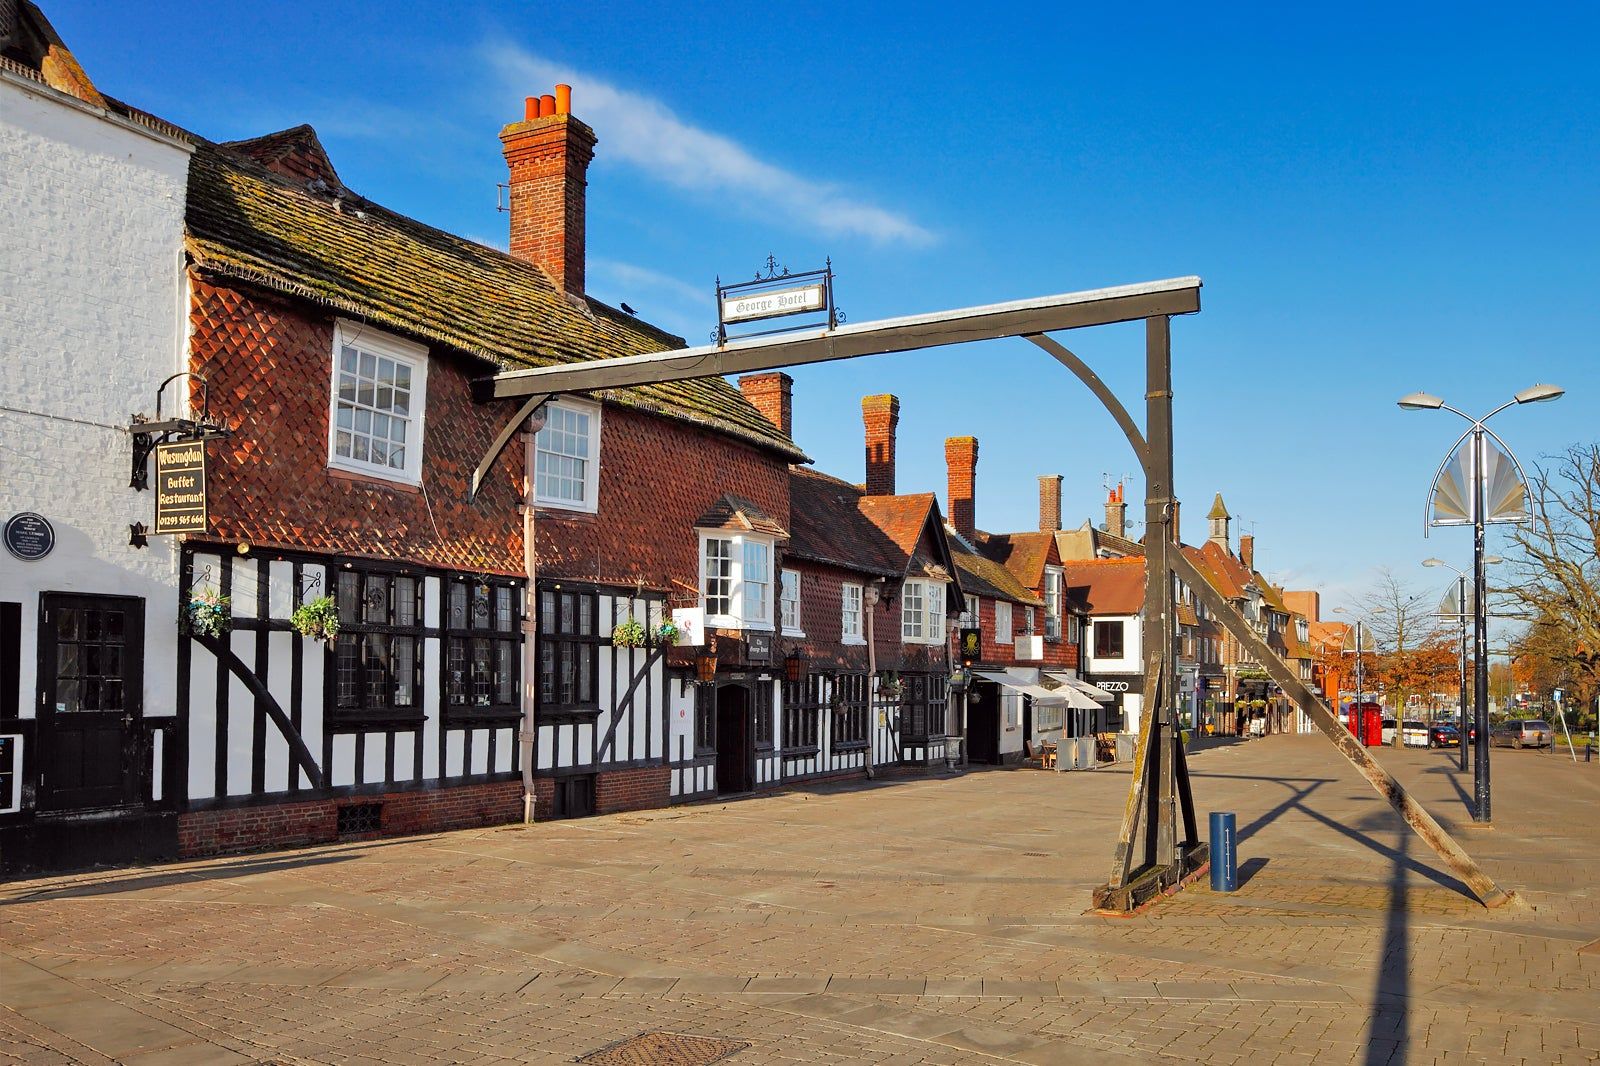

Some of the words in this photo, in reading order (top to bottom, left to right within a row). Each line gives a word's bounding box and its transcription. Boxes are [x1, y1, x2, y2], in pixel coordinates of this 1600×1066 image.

[736, 300, 773, 313] George
[777, 292, 806, 308] Hotel
[168, 476, 194, 488] Buffet
[160, 492, 204, 504] Restaurant
[160, 516, 178, 525] 01293
[179, 515, 190, 524] 565
[191, 514, 204, 524] 666
[1096, 682, 1128, 691] PREZZO
